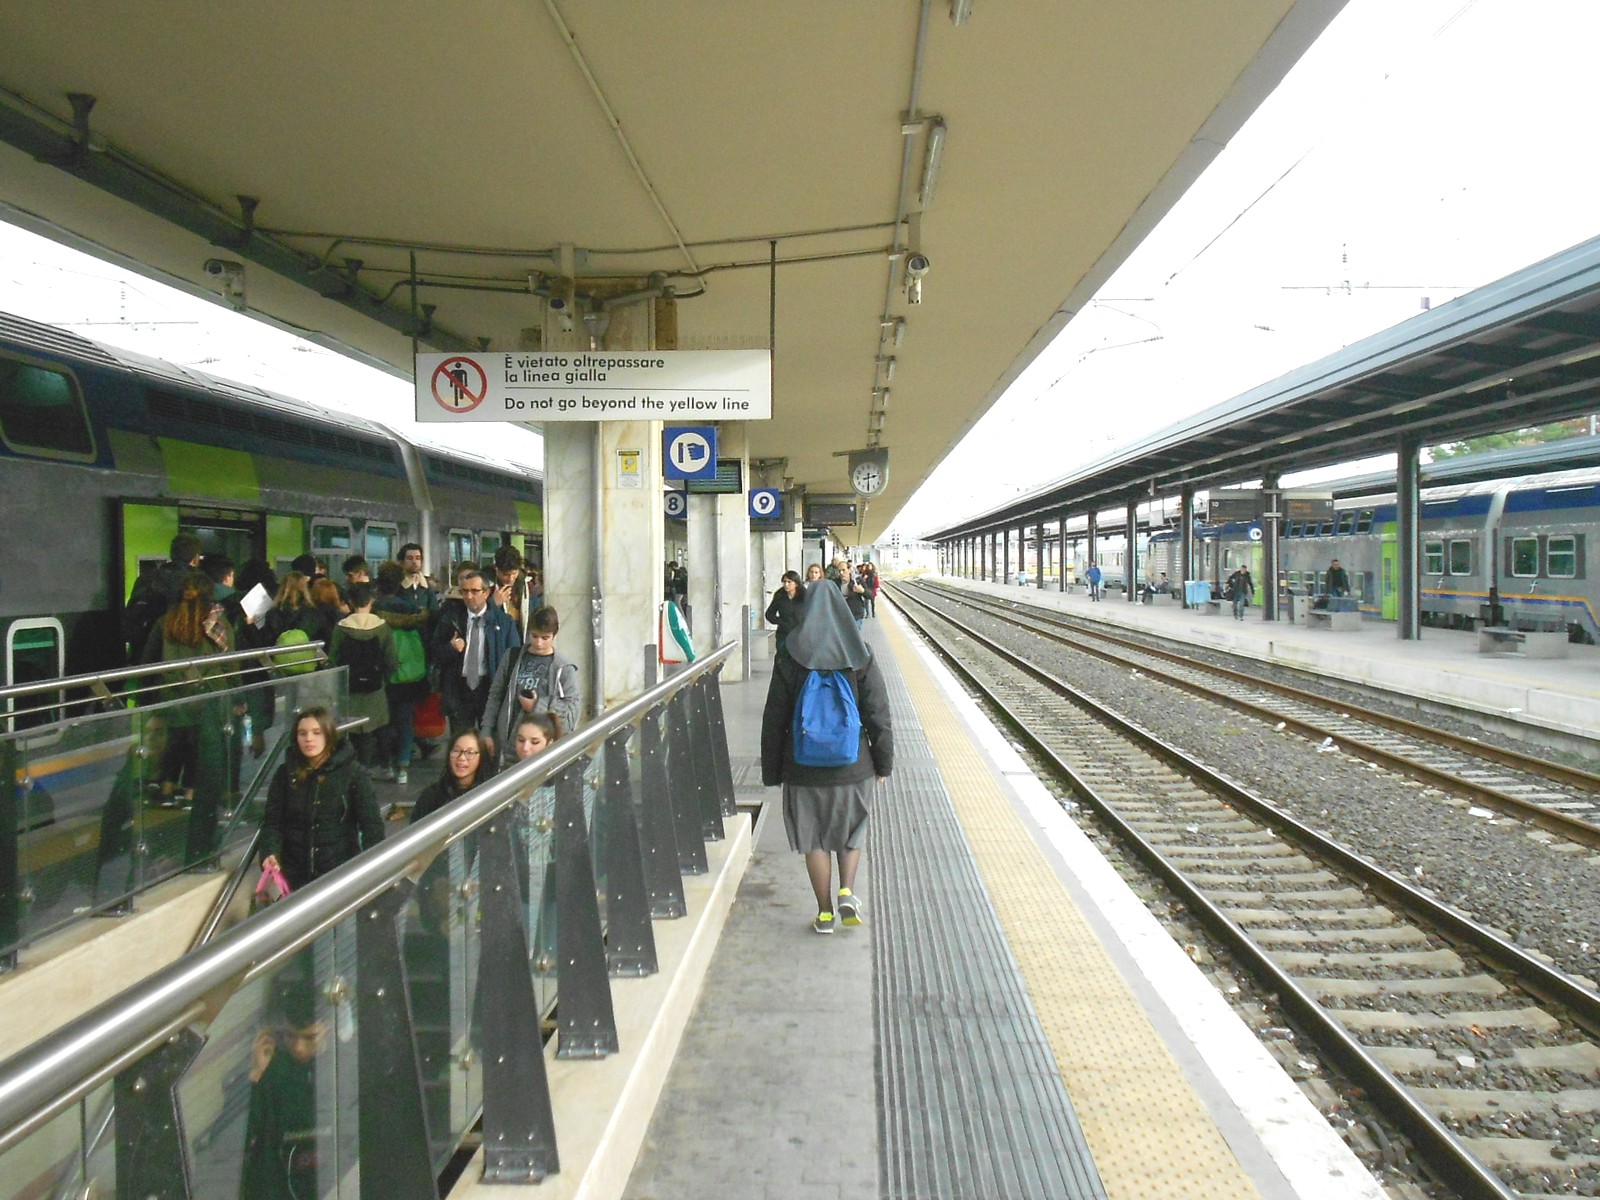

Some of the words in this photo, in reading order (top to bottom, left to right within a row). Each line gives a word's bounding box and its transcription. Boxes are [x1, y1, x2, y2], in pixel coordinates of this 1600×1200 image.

[504, 353, 513, 369] È
[517, 355, 569, 368] vietato
[573, 354, 665, 370] oltrepassare
[504, 370, 518, 383] la
[523, 370, 560, 382] linea
[565, 369, 607, 384] gialla
[504, 398, 525, 410] Do
[530, 397, 554, 409] not
[558, 399, 577, 411] go
[582, 396, 636, 411] beyond
[641, 396, 665, 409] the
[669, 397, 717, 412] yellow
[722, 397, 750, 410] line
[668, 497, 679, 511] 8
[759, 496, 770, 510] 9
